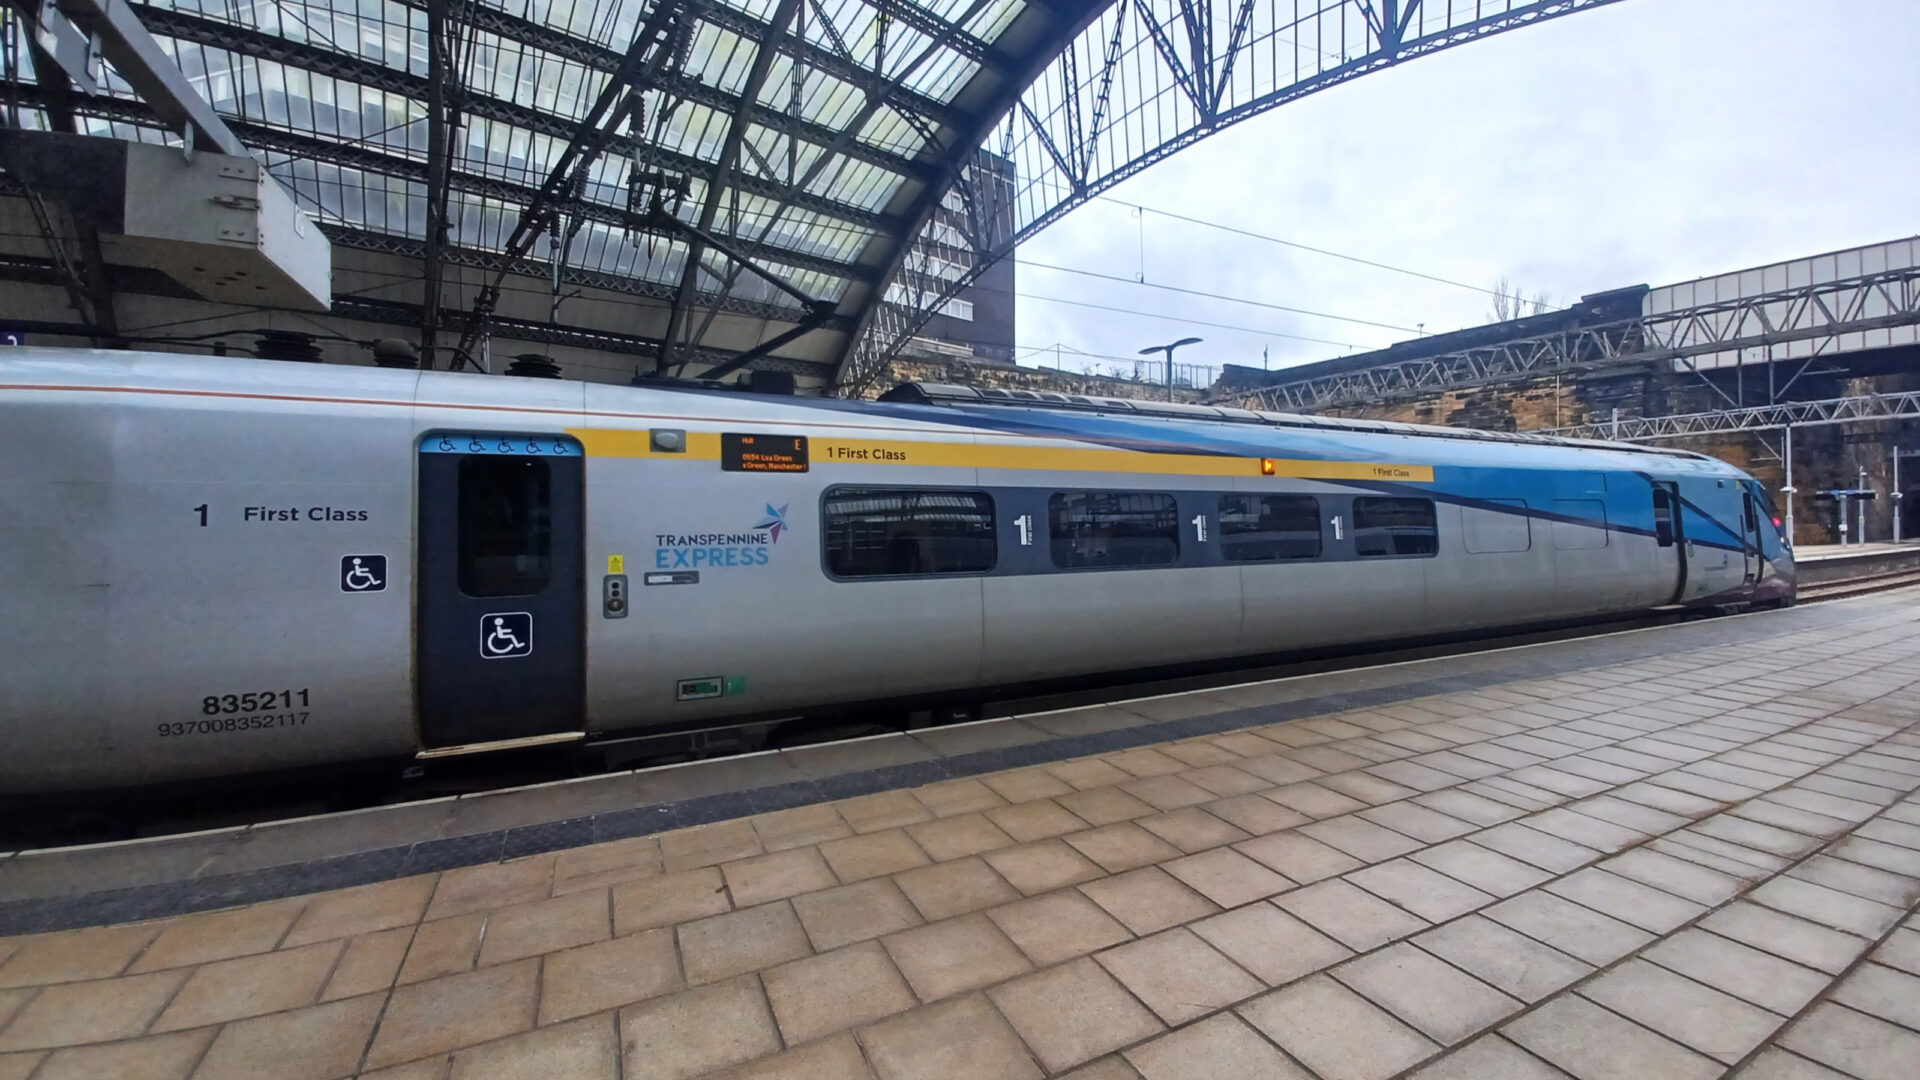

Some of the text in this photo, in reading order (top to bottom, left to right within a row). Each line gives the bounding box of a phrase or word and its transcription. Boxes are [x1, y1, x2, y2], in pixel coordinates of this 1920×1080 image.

[795, 439, 803, 451] E
[826, 446, 906, 461] 1 First Class
[1378, 468, 1392, 476] First
[193, 503, 368, 527] 1 First Class
[656, 533, 768, 546] TRANSPENNINE
[1013, 515, 1027, 545] 1
[1192, 514, 1203, 541] 1
[1331, 516, 1340, 540] 1
[656, 547, 769, 569] EXPRESS
[202, 688, 309, 715] 835211
[158, 712, 310, 737] 937008352117
